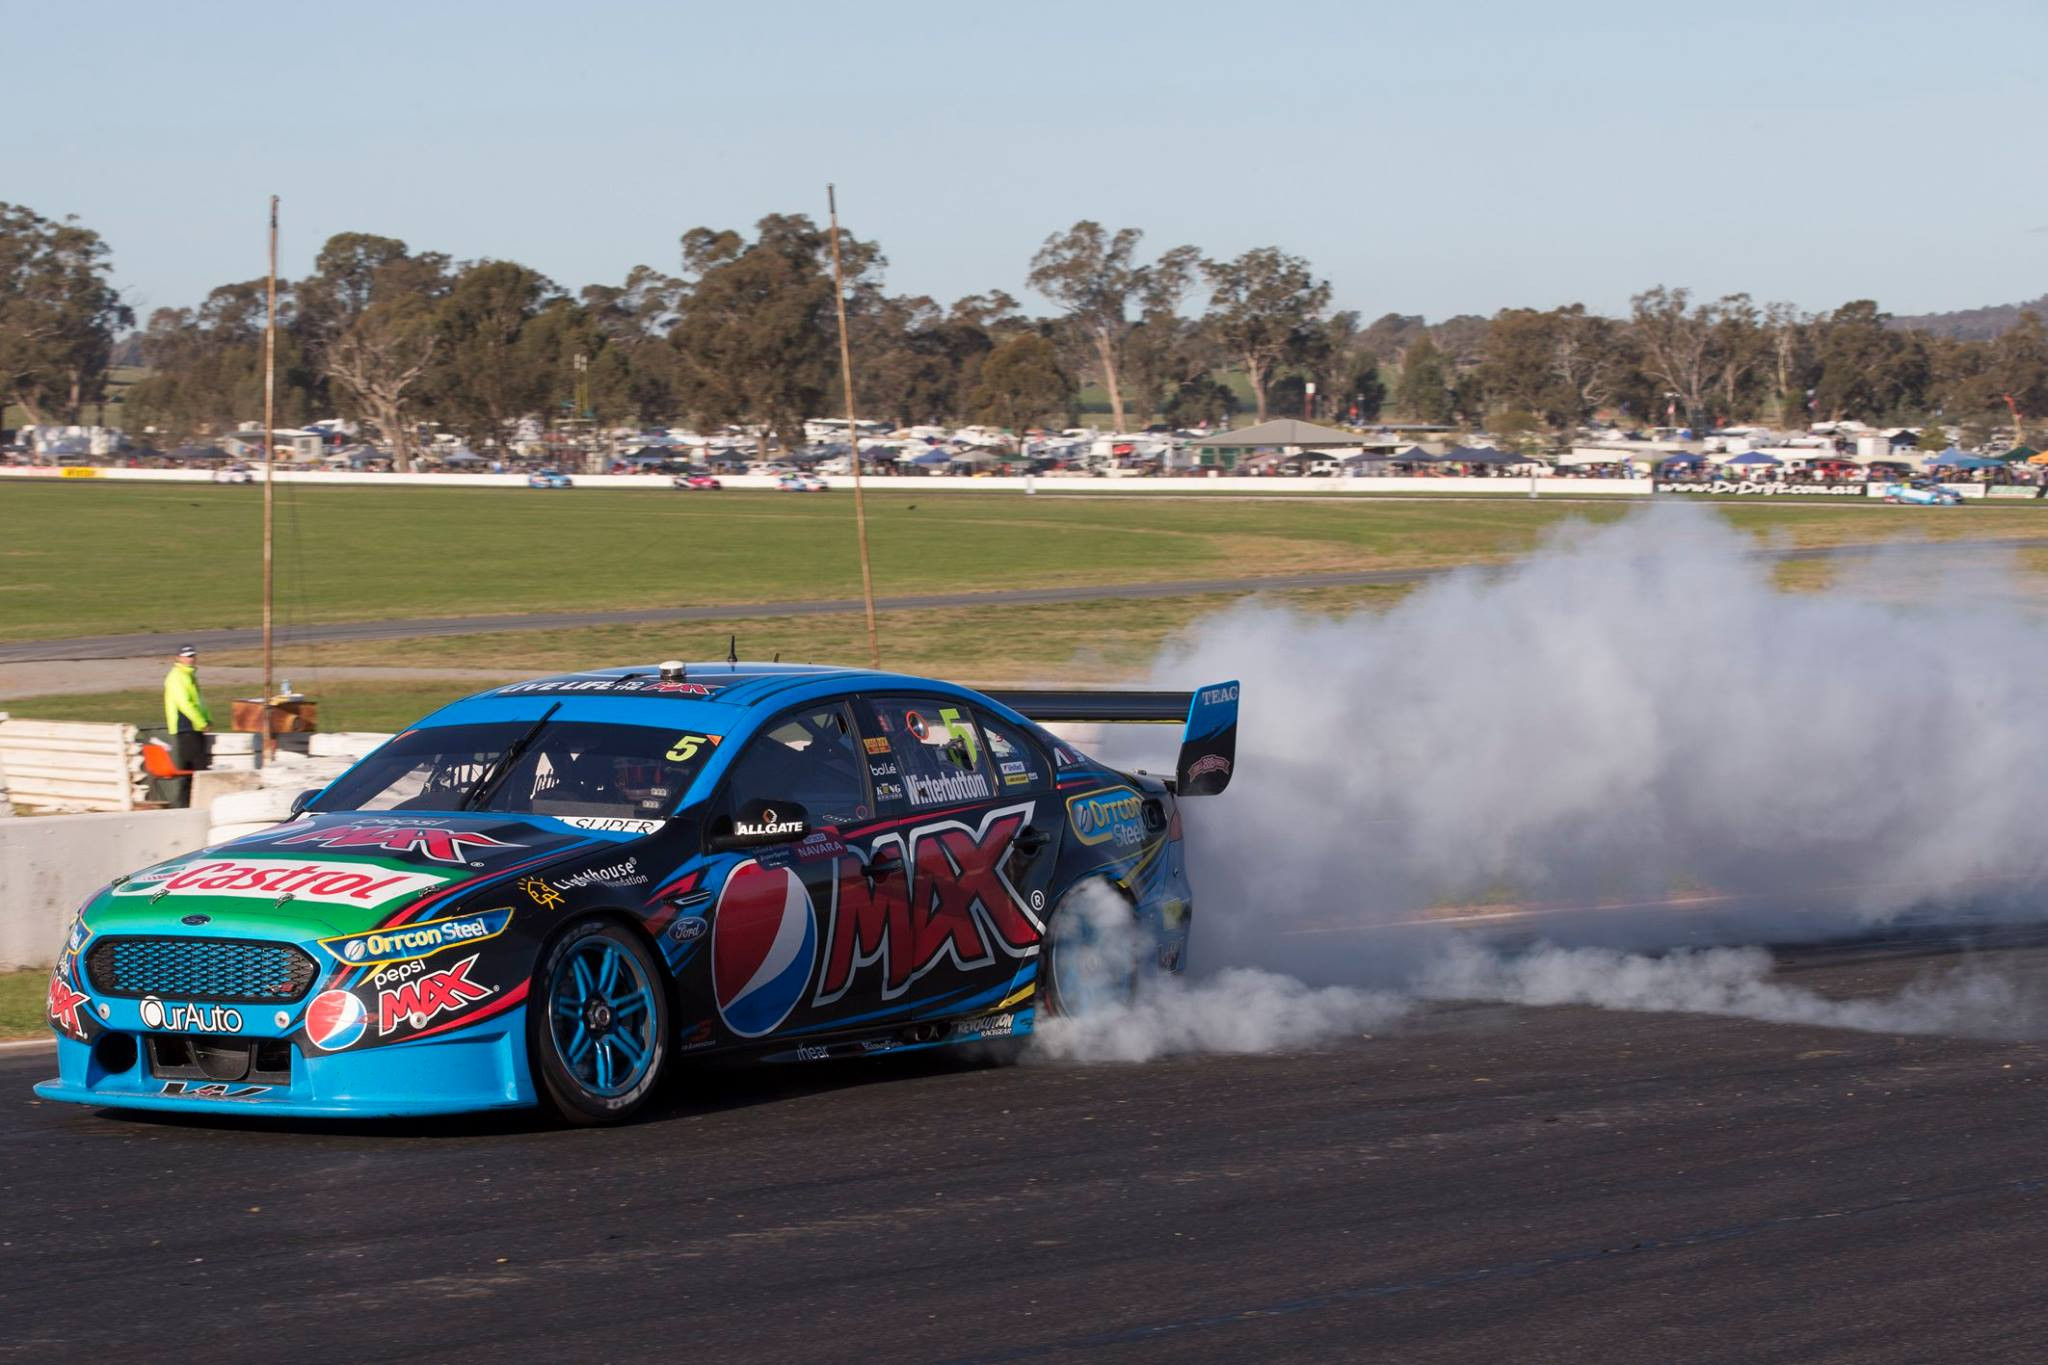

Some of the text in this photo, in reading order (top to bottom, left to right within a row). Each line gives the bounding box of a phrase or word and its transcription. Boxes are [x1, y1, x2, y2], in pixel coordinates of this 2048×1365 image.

[497, 681, 562, 693] LIVE
[562, 681, 617, 692] LIFE
[1202, 686, 1238, 705] TEAC
[665, 735, 707, 762] 5
[939, 708, 977, 769] 5
[905, 769, 989, 806] Winterbottom
[736, 821, 804, 836] ALLGATE
[1089, 797, 1143, 828] Orrcon
[271, 825, 532, 865] MAX
[1113, 817, 1147, 846] Steel
[797, 841, 842, 858] NAVARA
[165, 861, 411, 900] Castrol
[811, 801, 1046, 1007] MAX
[366, 918, 489, 956] Orrcon Steel
[674, 919, 704, 940] Ford
[374, 958, 426, 990] pepsi
[378, 952, 494, 1037] MAX
[140, 995, 243, 1033] OurAuto
